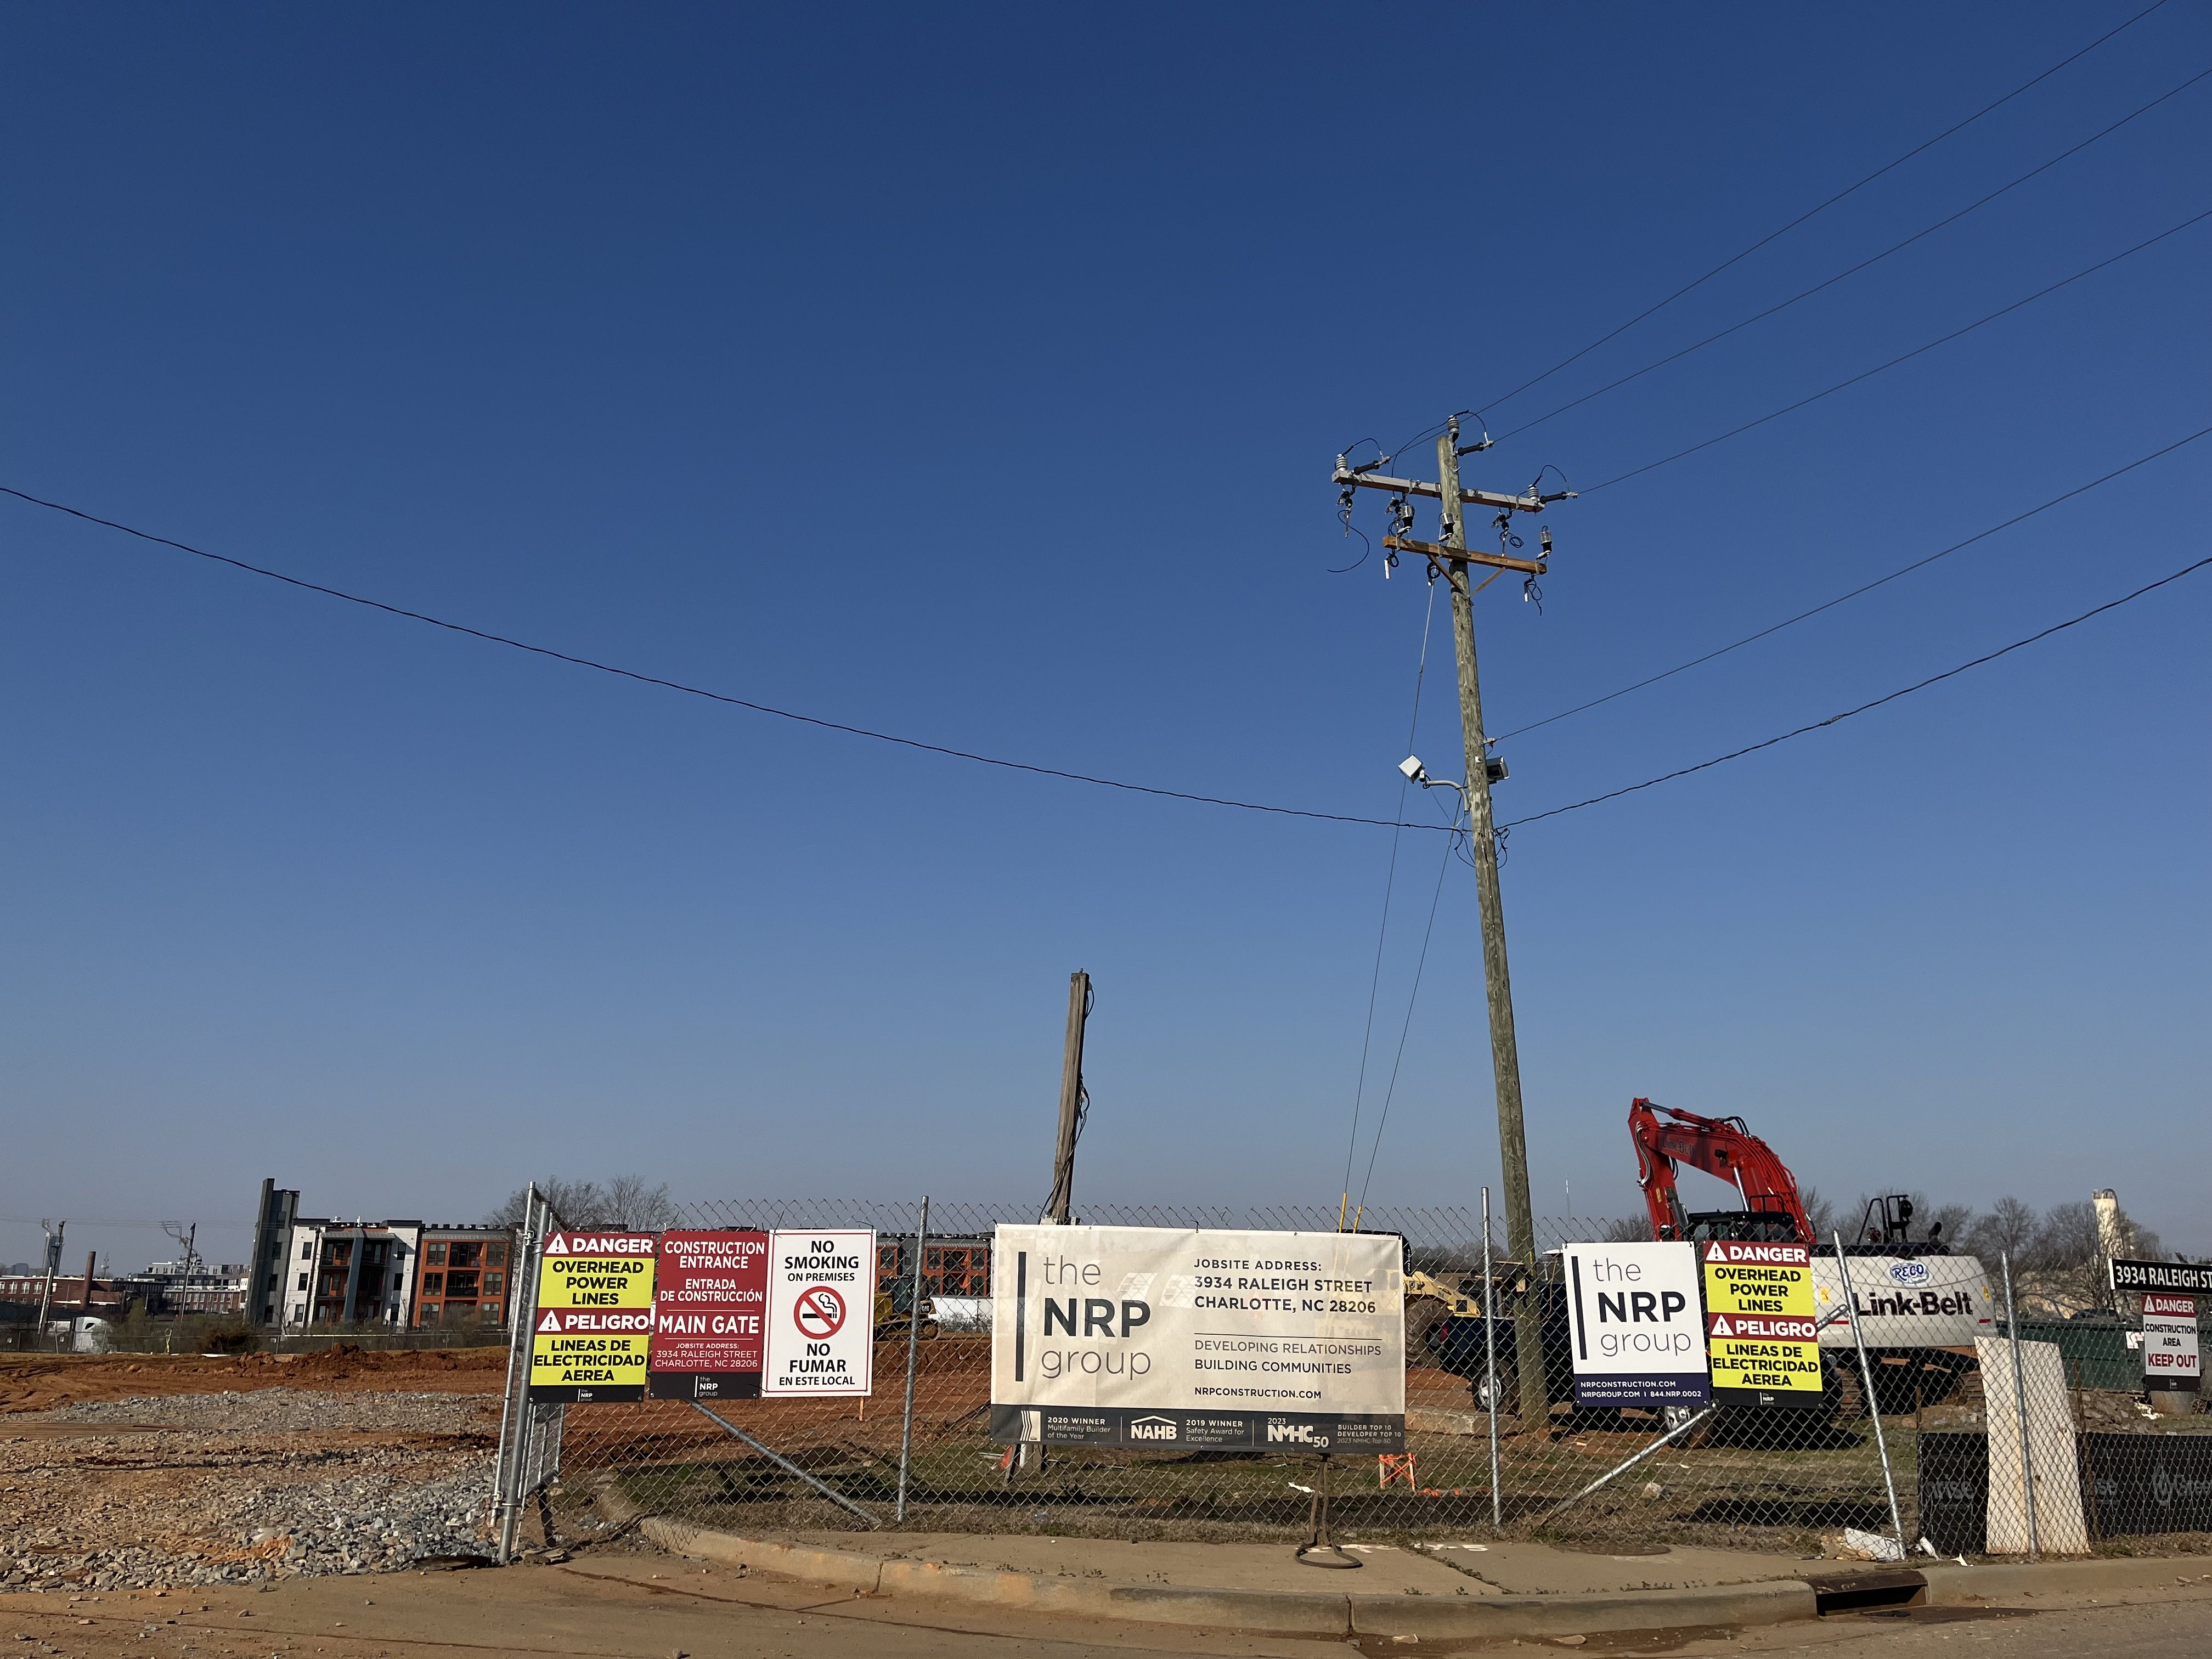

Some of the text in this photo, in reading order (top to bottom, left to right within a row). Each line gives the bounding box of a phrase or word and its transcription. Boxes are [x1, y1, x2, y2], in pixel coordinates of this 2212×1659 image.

[573, 1238, 653, 1253] DANGER
[665, 1241, 765, 1254] CONSTRUCTION
[811, 1240, 834, 1253] NO
[1729, 1246, 1807, 1262] DANGER
[552, 1261, 644, 1273] OVERHEAD
[679, 1256, 748, 1268] ENTRANCE
[785, 1256, 859, 1269] SMOKING
[1194, 1259, 1322, 1271] JOBSITE ADDRESS:
[1043, 1255, 1101, 1285] the
[1593, 1257, 1641, 1281] the
[1714, 1267, 1801, 1282] OVERHEAD
[1892, 1263, 1925, 1282] RECO
[566, 1277, 628, 1289] POWER
[787, 1272, 855, 1281] ON PREMISES
[2115, 1266, 2146, 1284] 3934
[2148, 1268, 2199, 1288] RALEIGH
[686, 1279, 736, 1289] ENTRADA
[1194, 1276, 1372, 1293] 3934 RALEIGH STREET
[1730, 1284, 1788, 1297] POWER
[572, 1293, 619, 1305] LINES
[661, 1289, 763, 1302] DE CONSTRUCCIÓN
[1195, 1296, 1376, 1313] CHARLOTTE, NC 28206
[1598, 1291, 1686, 1322] NRP
[1739, 1299, 1783, 1312] LINES
[1852, 1291, 1973, 1316] Link-Belt
[2156, 1299, 2194, 1313] DANGER
[565, 1315, 649, 1330] PELIGRO
[1044, 1297, 1150, 1338] NRP
[659, 1316, 759, 1334] MAIN GATE
[1735, 1320, 1816, 1338] PELIGRO
[2145, 1323, 2196, 1335] CONSTRUCTION
[551, 1340, 630, 1351] LINEAS DE
[1195, 1340, 1381, 1356] DEVELOPING RELATIONSHIPS
[1601, 1333, 1691, 1357] group
[2163, 1338, 2181, 1346] AREA
[807, 1343, 830, 1356] NO
[1726, 1344, 1802, 1357] LINEAS DE
[534, 1355, 645, 1366] ELECTRICIDAD
[655, 1359, 712, 1368] CHARLOTTE,
[789, 1359, 847, 1373] FUMAR
[1041, 1350, 1151, 1381] group
[1195, 1359, 1352, 1374] BUILDING COMMUNITIES
[1713, 1358, 1818, 1372] ELECTRICIDAD
[2148, 1353, 2197, 1368] KEEP OUT
[561, 1369, 614, 1381] AEREA
[779, 1376, 855, 1385] EN ESTE LOCAL
[1742, 1373, 1792, 1386] AEREA
[1195, 1387, 1322, 1399] NRPCONSTRUCTION.COM
[1047, 1425, 1084, 1433] Multifamily
[1131, 1425, 1177, 1440] NAHB
[1267, 1425, 1329, 1448] NMHC 50
